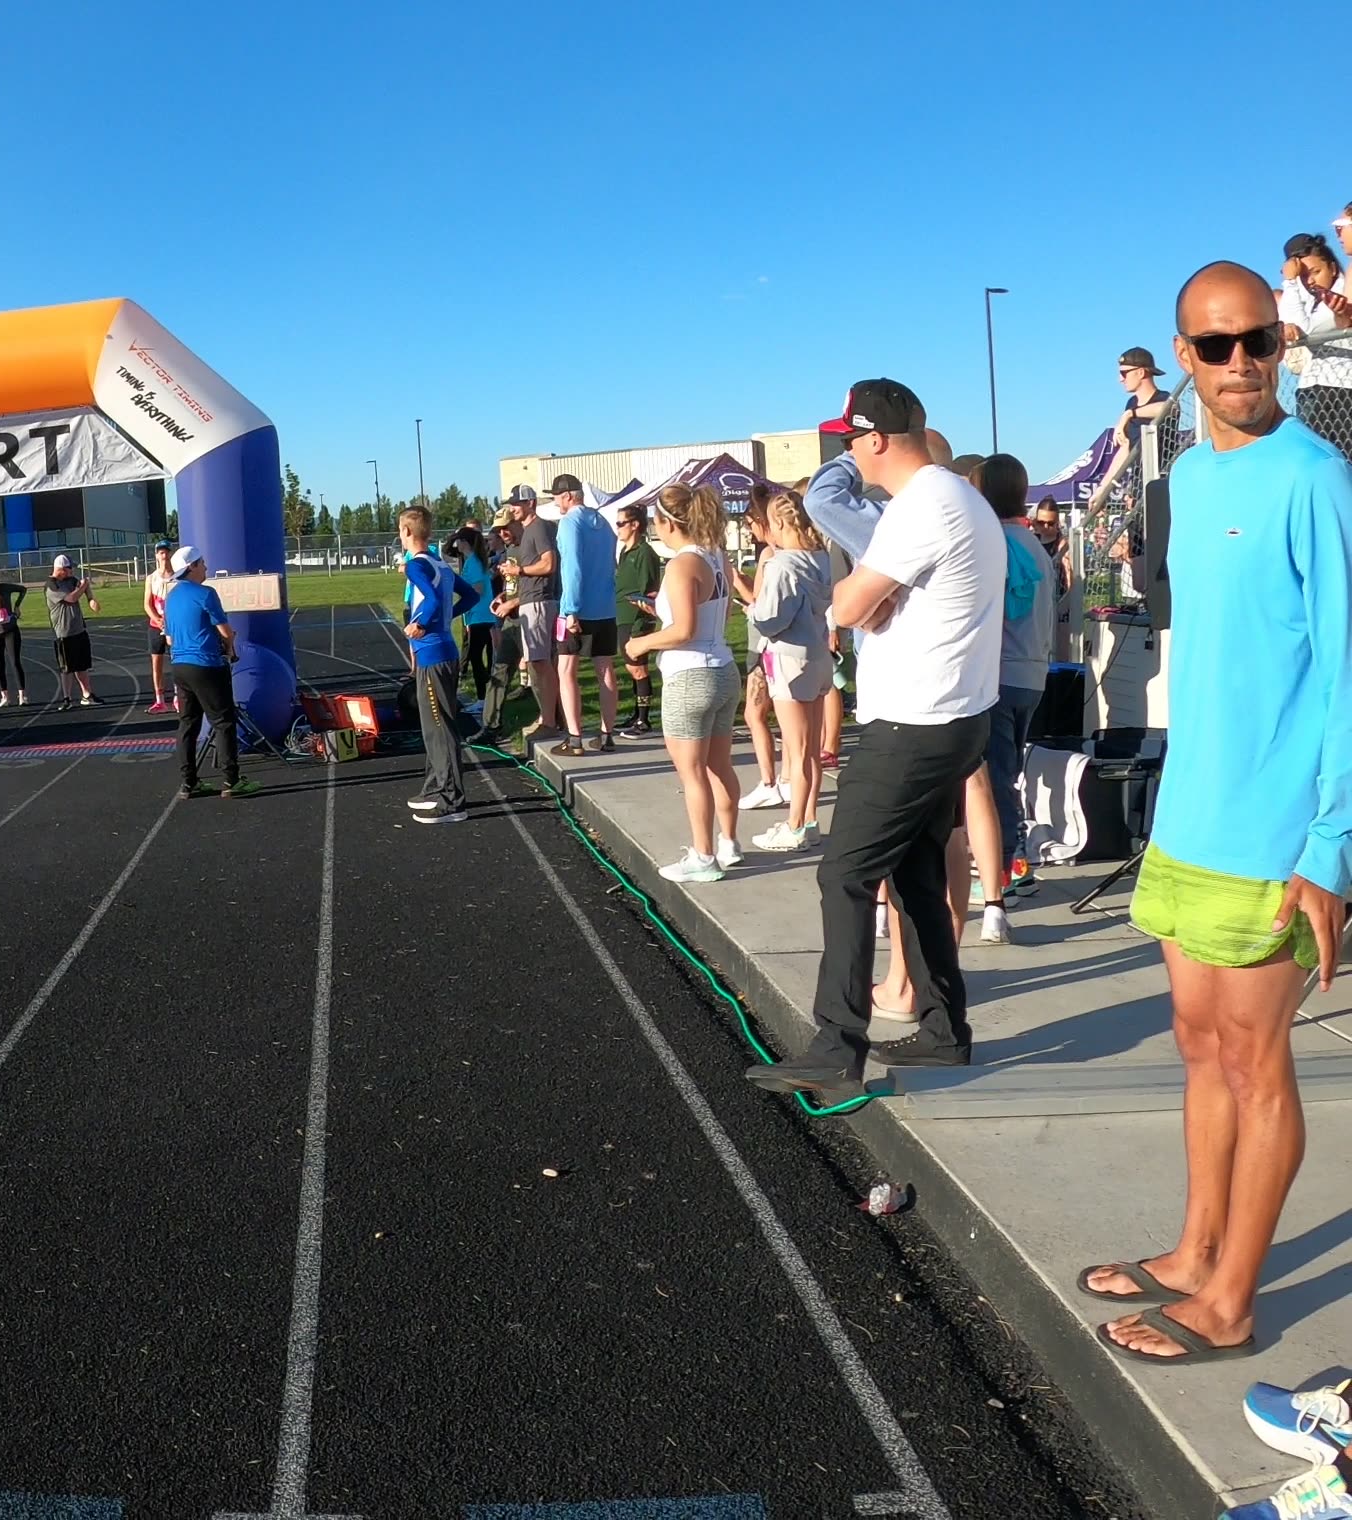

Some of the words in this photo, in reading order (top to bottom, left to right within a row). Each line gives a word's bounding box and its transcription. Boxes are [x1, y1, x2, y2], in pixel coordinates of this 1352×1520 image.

[116, 366, 145, 391] TIMING
[145, 391, 156, 400] IS
[128, 339, 174, 384] VECTOR
[173, 384, 213, 423] TIMING
